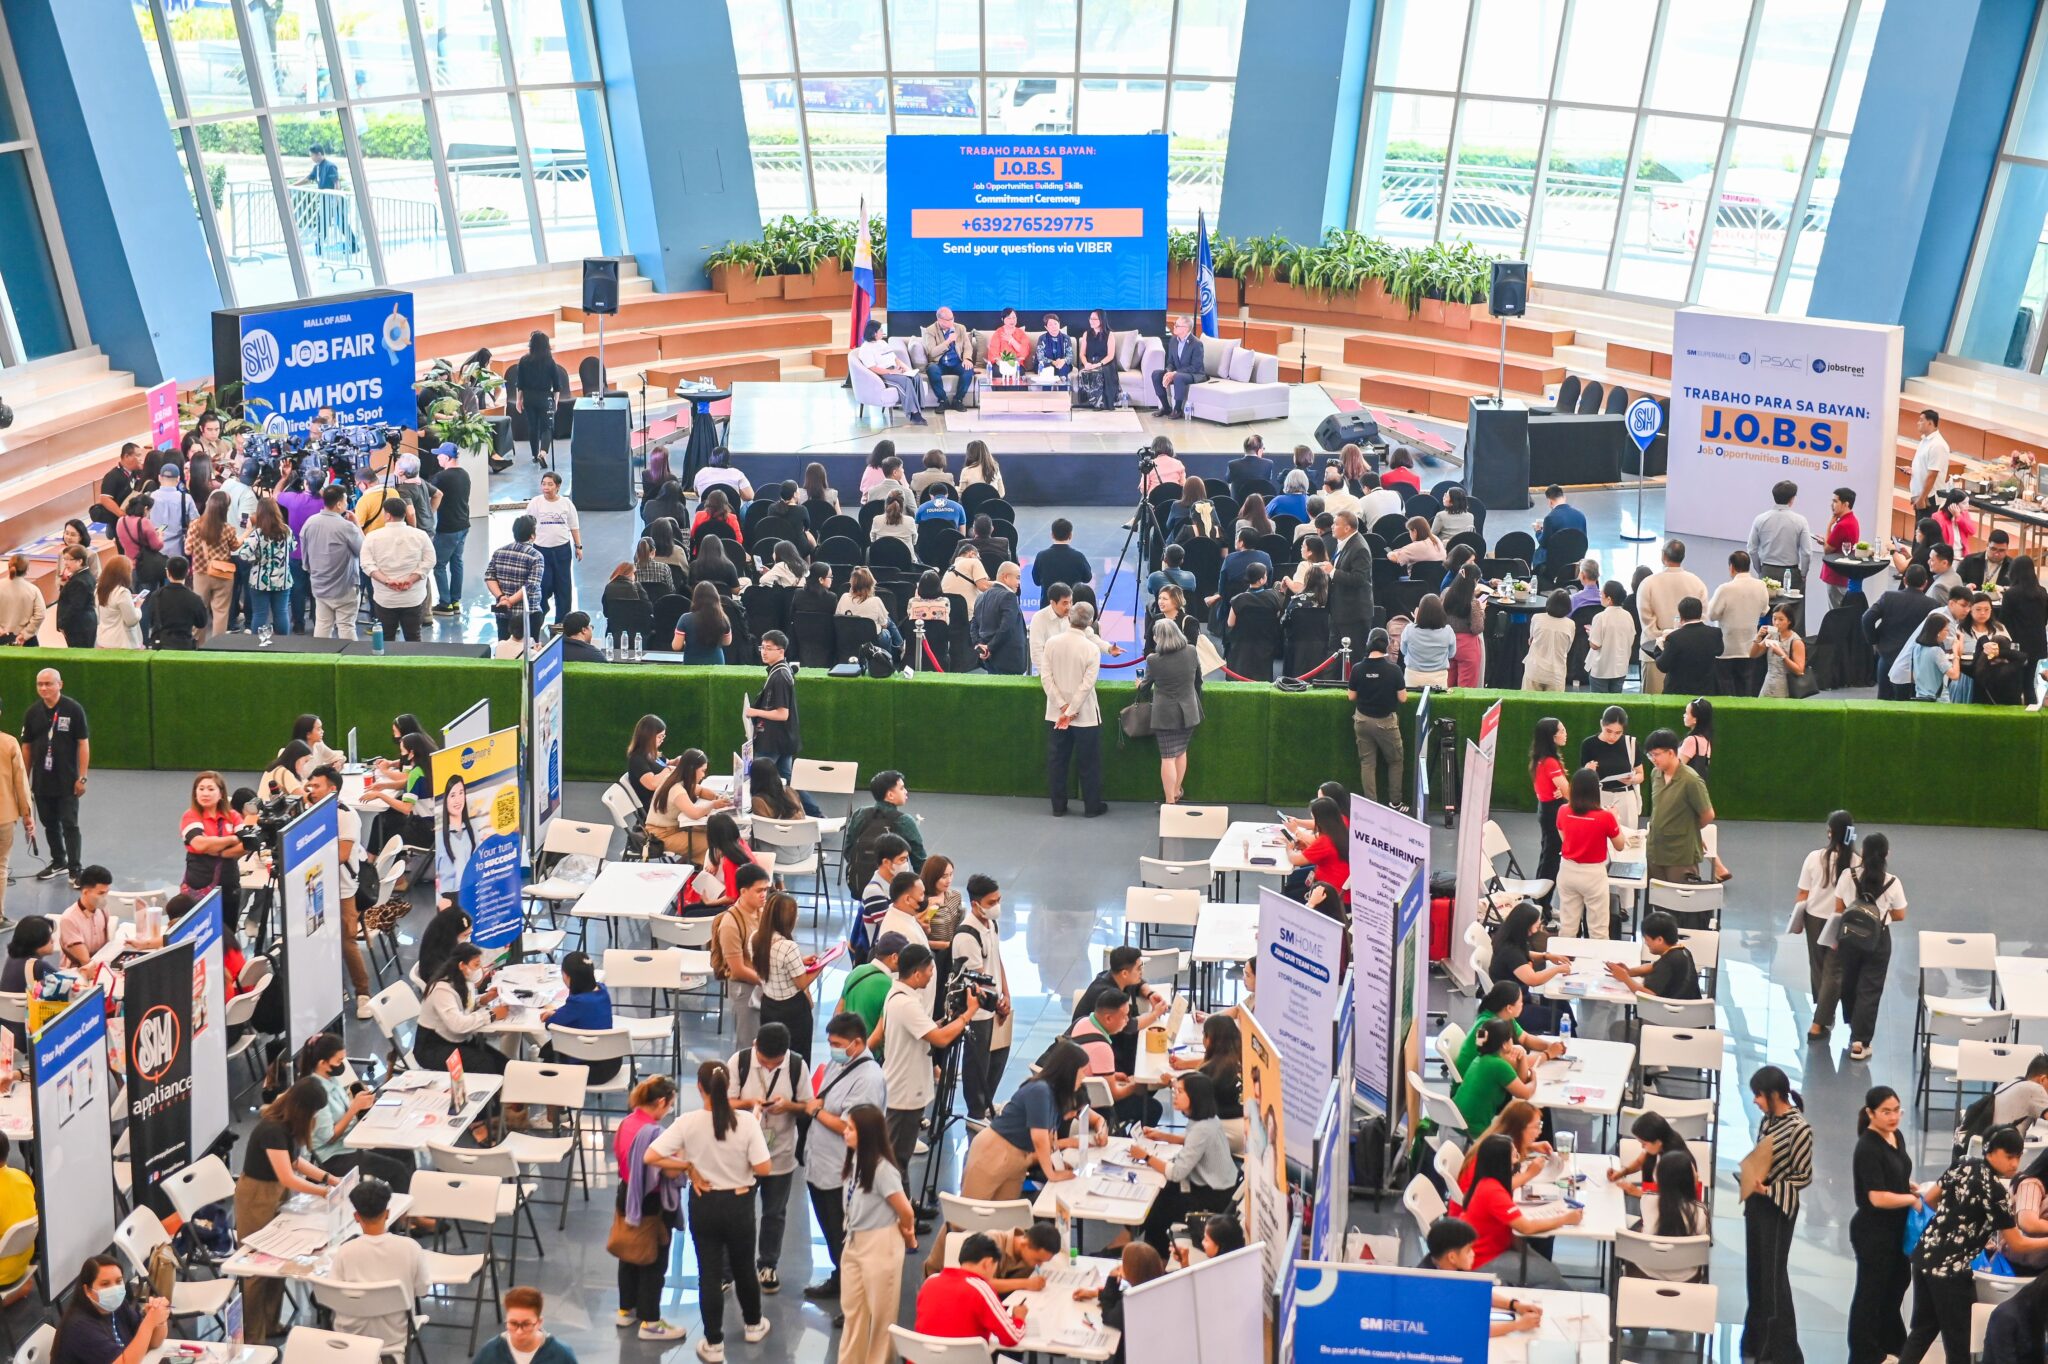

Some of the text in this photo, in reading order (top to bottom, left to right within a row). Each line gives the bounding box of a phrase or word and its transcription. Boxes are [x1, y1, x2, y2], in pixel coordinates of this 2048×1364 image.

[960, 146, 1097, 155] TRABAHO PARA SA BAYAN:
[1000, 161, 1055, 176] J.O.B.S.
[973, 182, 1083, 191] Job Opportunities Building Skills
[975, 194, 1081, 206] Commitment Ceremony
[962, 217, 1094, 232] +639276529775
[943, 241, 1112, 256] Send your questions via VIBER
[303, 314, 352, 328] MALL OF ASIA
[285, 333, 376, 368] JOB FAIR
[1760, 355, 1802, 369] PSAC
[1827, 362, 1865, 374] jobstreet
[279, 377, 383, 414] I AM HOTS
[1684, 386, 1870, 419] TRABAHO PARA SA BAYAN:
[356, 406, 384, 424] Spot
[1634, 406, 1656, 432] SM
[1705, 410, 1843, 454] J.O.B.S.
[1697, 445, 1848, 473] Job Opportunities Building Skills
[1354, 829, 1371, 844] WE
[1371, 837, 1389, 852] ARE
[479, 847, 497, 860] Your
[475, 862, 484, 872] to
[1280, 927, 1295, 944] SM
[1295, 935, 1323, 959] HOME
[55, 1028, 82, 1058] Appliance
[81, 1014, 100, 1036] Center
[138, 1011, 173, 1074] SM
[132, 1074, 193, 1121] appliance
[1360, 1317, 1428, 1335] SM RETAIL
[1320, 1344, 1330, 1354] Be
[1332, 1346, 1348, 1355] part
[1349, 1346, 1358, 1355] of
[1358, 1347, 1371, 1356] the
[1372, 1350, 1406, 1361] country's
[1407, 1352, 1435, 1363] leading
